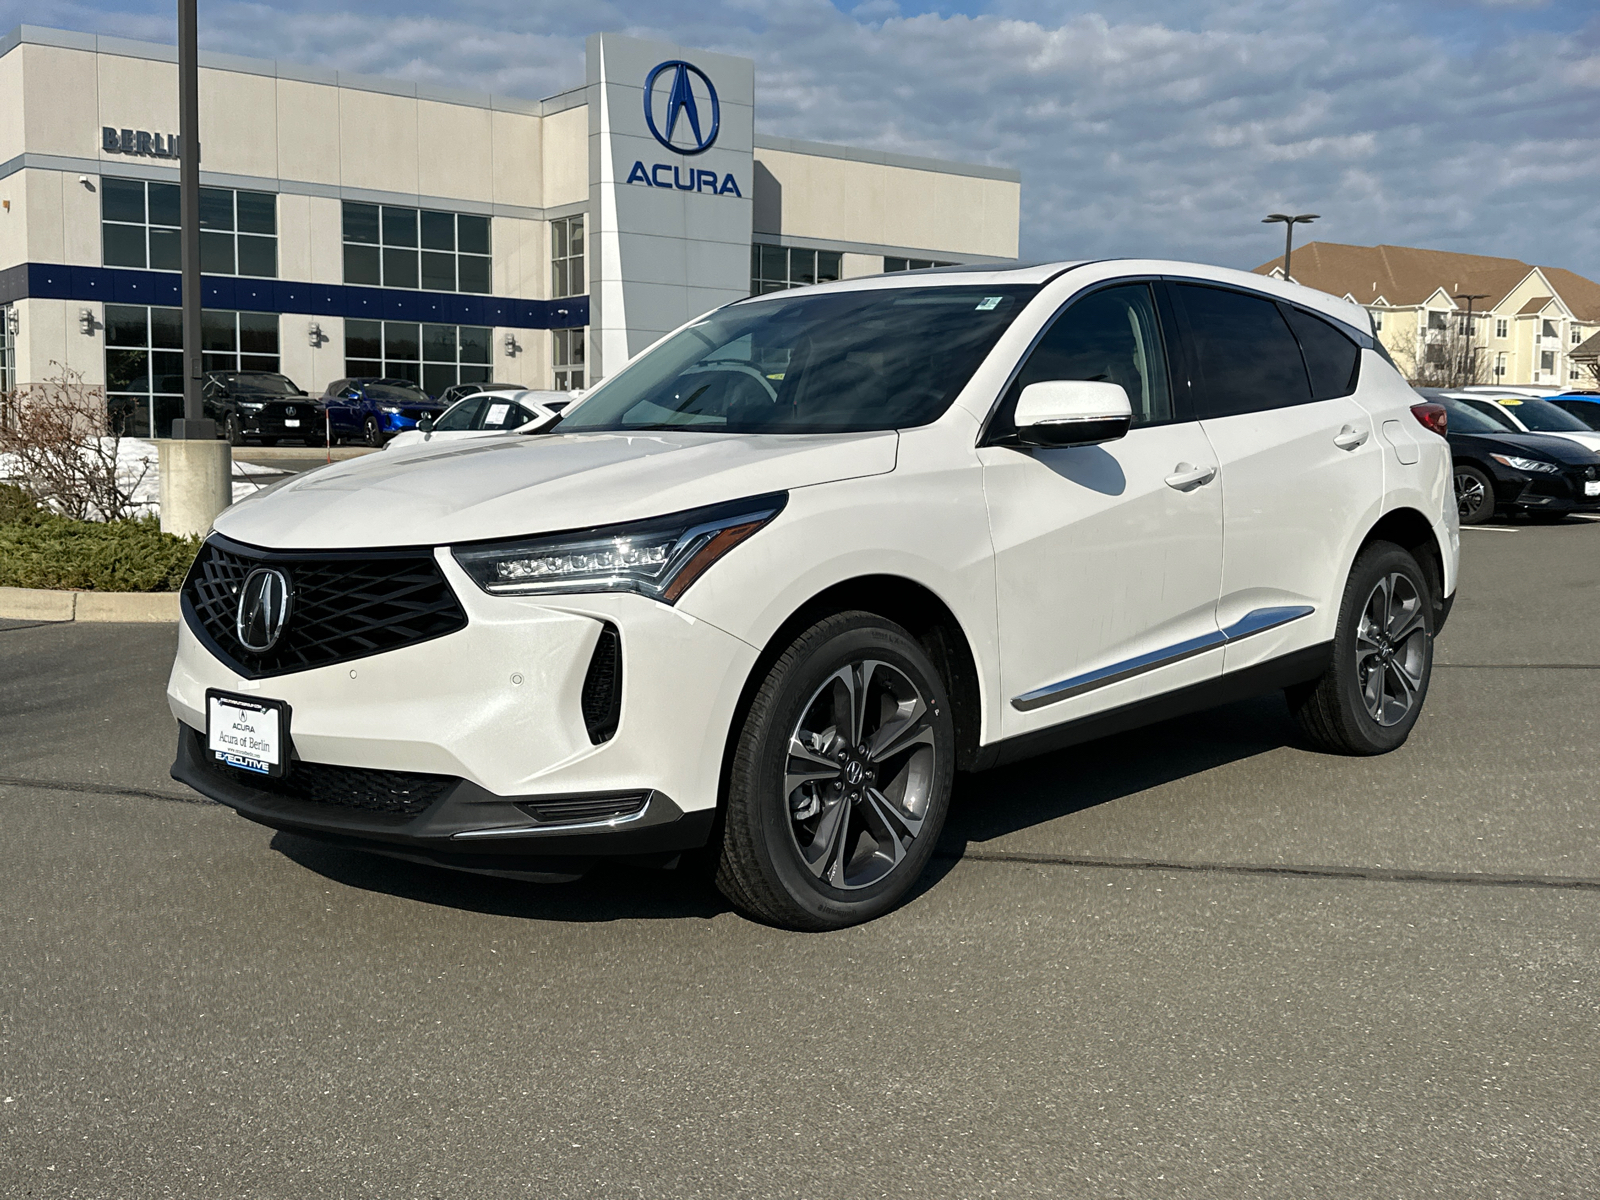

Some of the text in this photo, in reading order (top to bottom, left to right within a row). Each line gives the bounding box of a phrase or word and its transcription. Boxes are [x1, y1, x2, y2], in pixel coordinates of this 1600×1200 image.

[102, 126, 200, 163] BERLI
[626, 160, 743, 198] ACURA
[232, 723, 255, 733] ACURA
[219, 731, 270, 752] Acura of Berlin
[215, 751, 270, 771] EXECUTIVE
